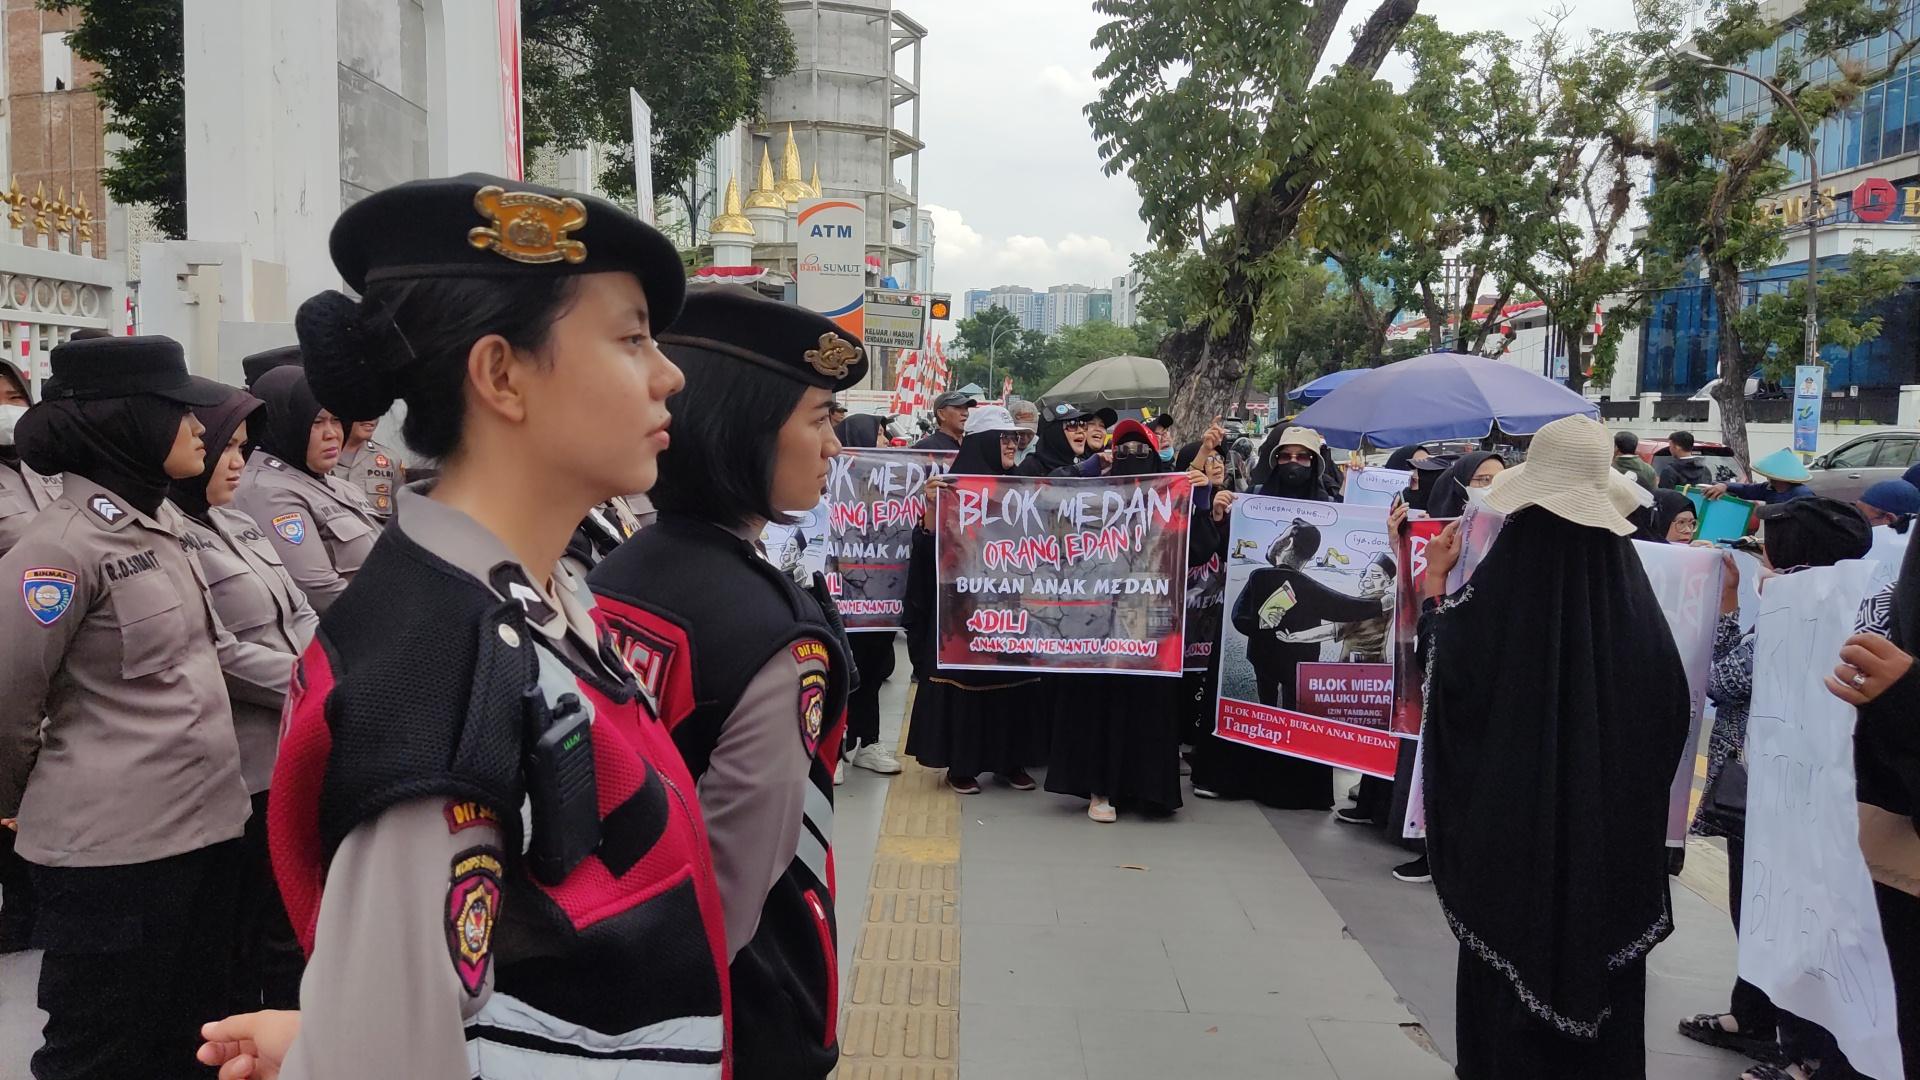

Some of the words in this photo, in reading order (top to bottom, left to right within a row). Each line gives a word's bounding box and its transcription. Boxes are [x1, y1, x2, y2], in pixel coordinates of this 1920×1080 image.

[810, 224, 852, 238] ATM
[800, 263, 822, 272] Bank
[823, 263, 861, 273] SUMUT
[864, 328, 888, 337] KELUAR
[892, 330, 914, 338] MASUK
[367, 469, 393, 477] POLRI
[42, 476, 63, 485] POL
[956, 487, 1045, 535] BLOK
[1058, 486, 1172, 536] MEDAN
[842, 544, 889, 559] ANAK
[983, 534, 1060, 571] ORANG
[1065, 526, 1129, 566] EDAN
[33, 571, 67, 579] BINMAS
[955, 576, 1025, 594] BUKAN
[1031, 578, 1087, 595] ANAK
[1093, 578, 1169, 595] MEDAN
[966, 609, 1028, 633] ADILI
[970, 637, 1005, 653] ANAK
[1007, 638, 1034, 653] DAN
[1037, 639, 1100, 655] MENANTU
[1101, 639, 1158, 657] JOKOWI
[1308, 678, 1347, 691] BLOK
[1351, 679, 1393, 692] MEDA
[1314, 693, 1358, 703] MALUKU
[1361, 694, 1391, 704] UTAR
[1223, 715, 1283, 744] Tangkap
[1224, 704, 1250, 721] BLOK
[1257, 710, 1289, 728] MEDAN,
[1289, 719, 1324, 735] BUKAN
[1326, 727, 1355, 742] ANAK
[1357, 733, 1397, 750] MEDAN
